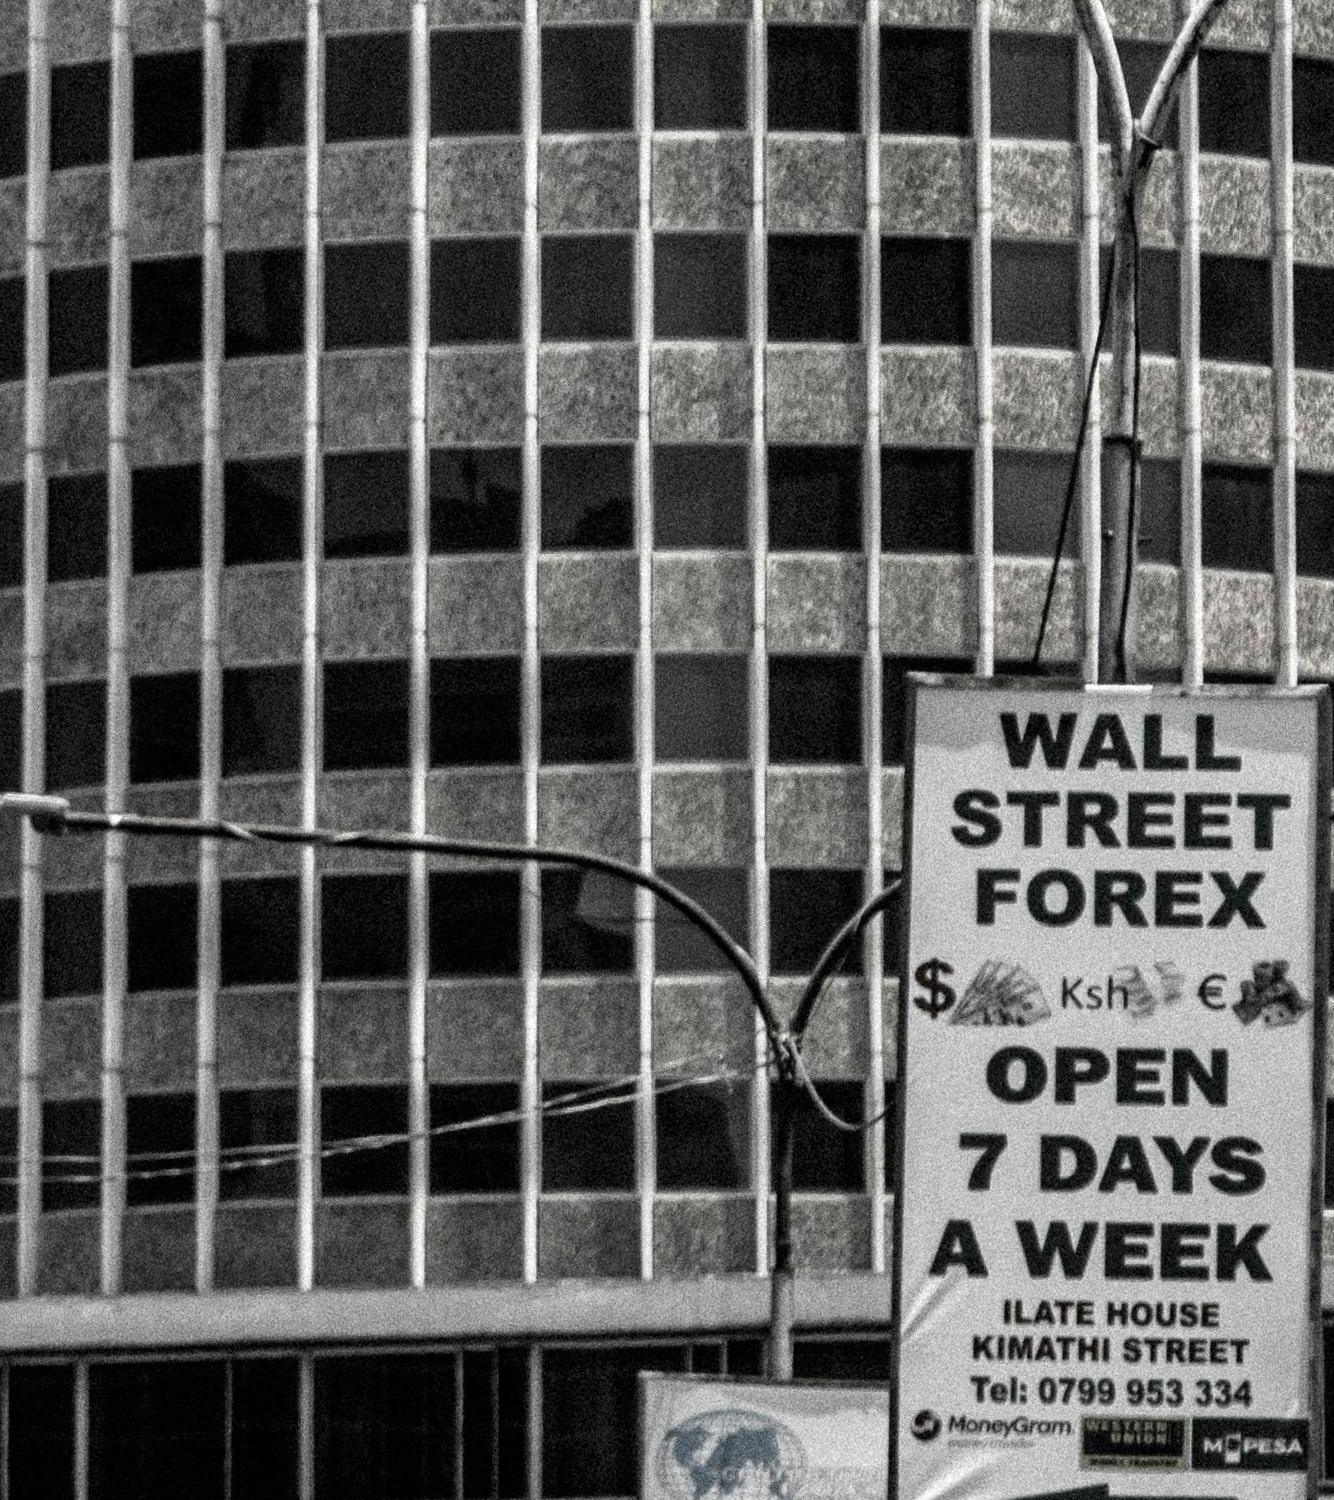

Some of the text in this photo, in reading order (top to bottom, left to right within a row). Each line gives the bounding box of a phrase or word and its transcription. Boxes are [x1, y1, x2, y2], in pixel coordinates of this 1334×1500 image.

[999, 712, 1241, 771] WALL
[951, 790, 1291, 850] STREET
[976, 868, 1266, 929] FOREX
[1061, 976, 1129, 1010] Ksh
[985, 1045, 1229, 1107] OPEN
[959, 1133, 1266, 1195] 7 DAYS
[928, 1220, 1273, 1282] A WEEK
[1003, 1299, 1220, 1328] ILATE HOUSE
[972, 1336, 1250, 1365] KIMATHI STREET
[969, 1376, 1253, 1408] Tel: 0799 953 334
[948, 1414, 1072, 1438] MoneyGram
[1111, 1432, 1167, 1444] UNION
